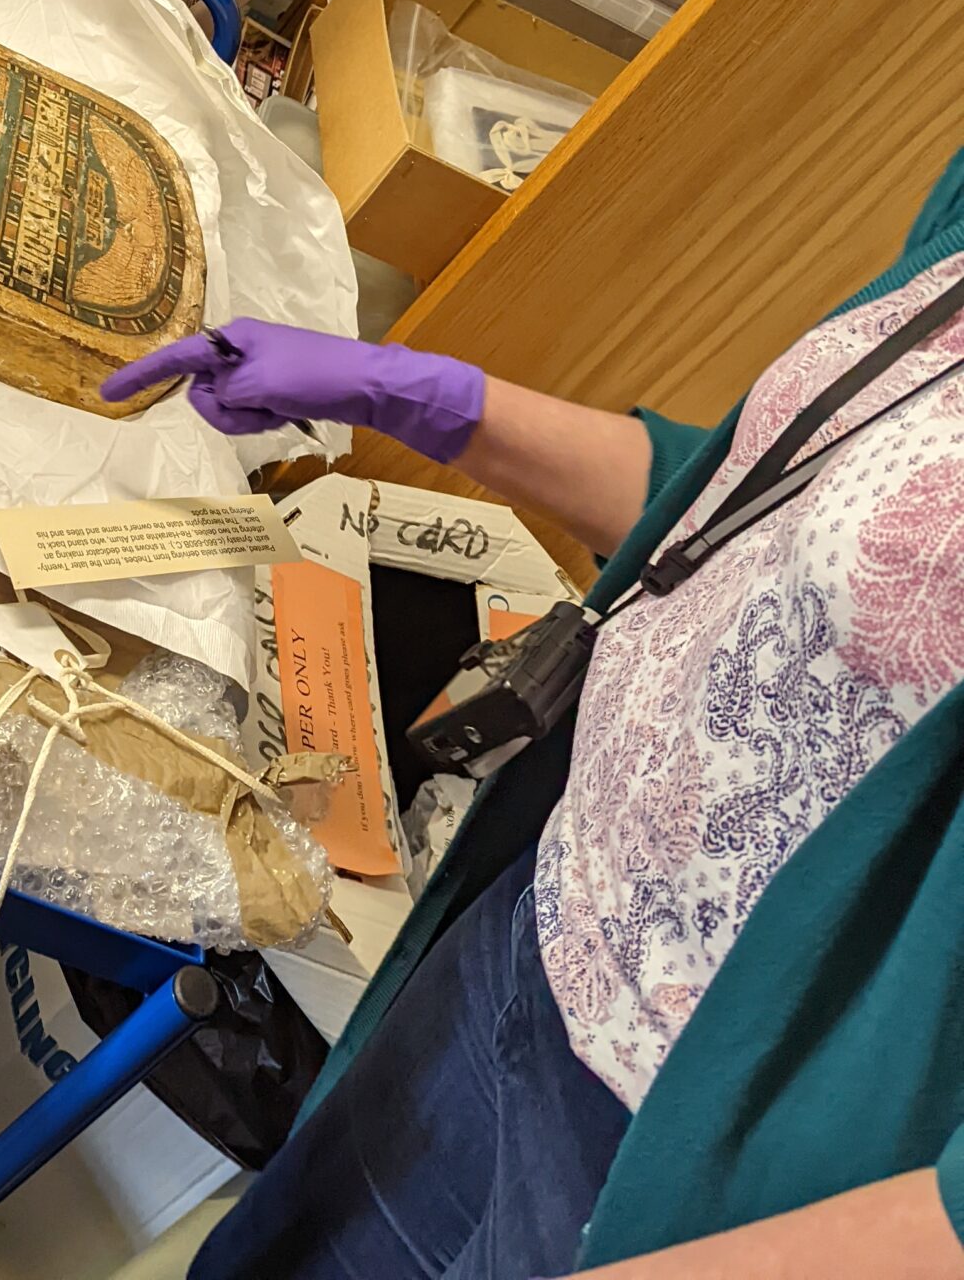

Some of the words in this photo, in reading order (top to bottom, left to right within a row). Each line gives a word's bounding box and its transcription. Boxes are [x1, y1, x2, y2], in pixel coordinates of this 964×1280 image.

[209, 508, 221, 516] the
[229, 506, 255, 515] offering
[152, 521, 164, 529] the
[166, 520, 183, 528] state
[184, 515, 224, 527] hieroglyphs
[224, 516, 239, 525] The
[85, 527, 99, 535] and
[123, 522, 151, 532] owner's
[239, 524, 265, 533] offering
[36, 531, 48, 539] his
[49, 529, 64, 537] and
[66, 528, 84, 536] titles
[89, 537, 106, 545] who
[130, 533, 144, 541] and
[226, 534, 251, 544] dynasty
[47, 540, 66, 549] back
[67, 538, 88, 547] stand
[85, 546, 120, 556] dedicator
[121, 545, 133, 553] the
[134, 543, 158, 552] shows
[200, 548, 217, 556] stela
[218, 545, 245, 554] wooden
[55, 548, 83, 559] making
[153, 552, 170, 561] from
[171, 548, 199, 559] deriving
[70, 560, 88, 569] later
[89, 559, 101, 567] the
[103, 557, 120, 566] from
[37, 561, 69, 572] Twenty-
[337, 621, 346, 636] ask
[339, 637, 350, 666] please
[291, 628, 311, 697] ONLY
[322, 647, 332, 676] You!
[343, 667, 352, 690] goes
[326, 680, 337, 716] Thank
[344, 689, 354, 711] card
[301, 703, 316, 751] PER
[348, 712, 357, 741] where
[358, 802, 368, 820] you
